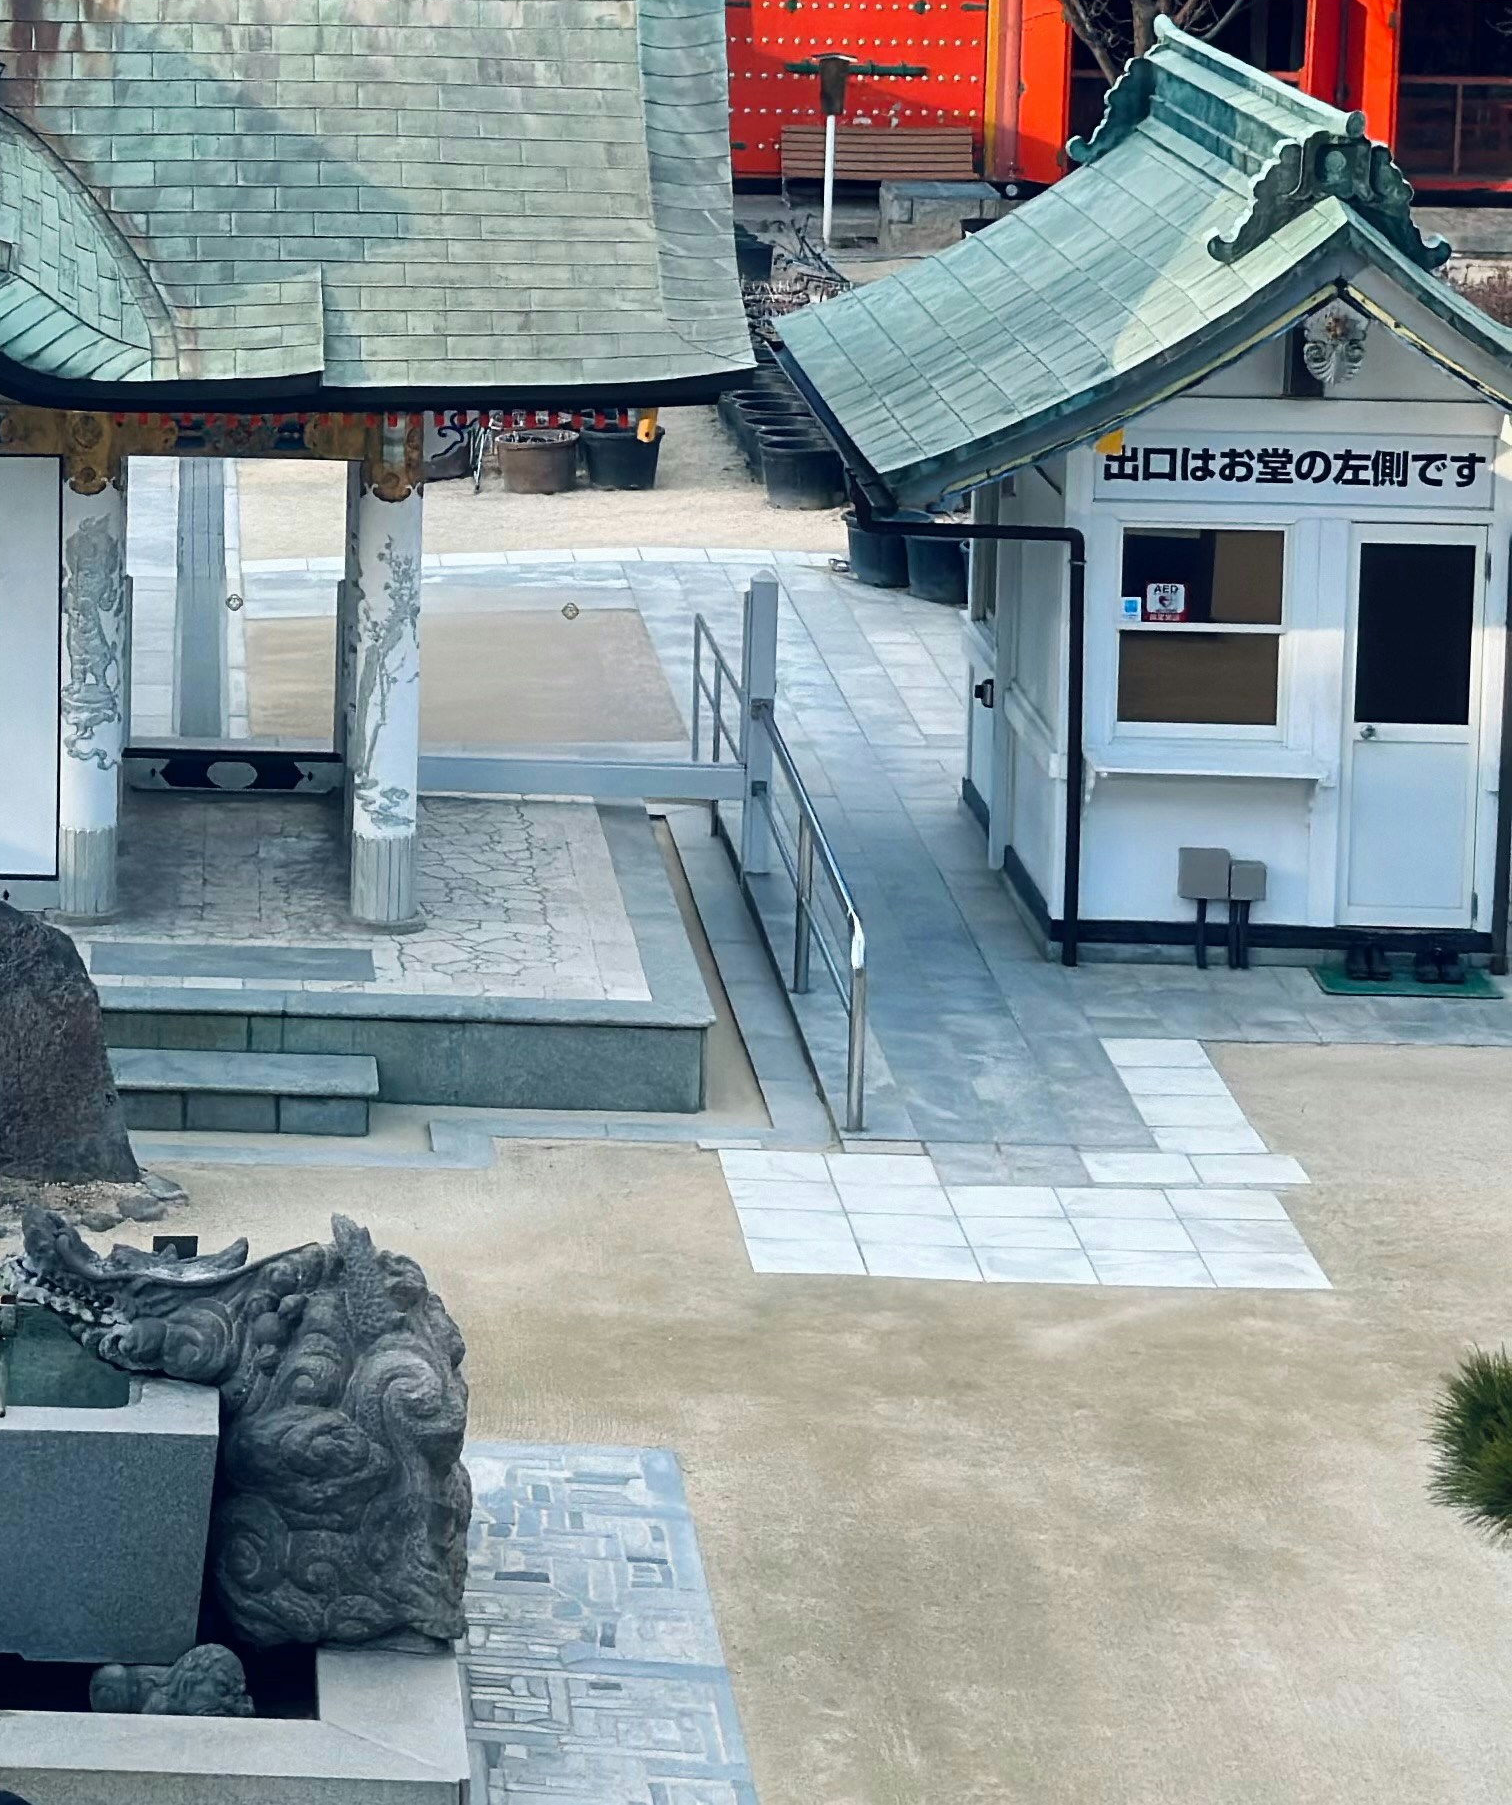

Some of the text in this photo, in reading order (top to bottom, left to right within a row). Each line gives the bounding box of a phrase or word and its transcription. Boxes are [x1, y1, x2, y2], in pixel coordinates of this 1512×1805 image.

[1103, 447, 1486, 487] 出口はお堂の左側です
[1154, 584, 1179, 594] AED
